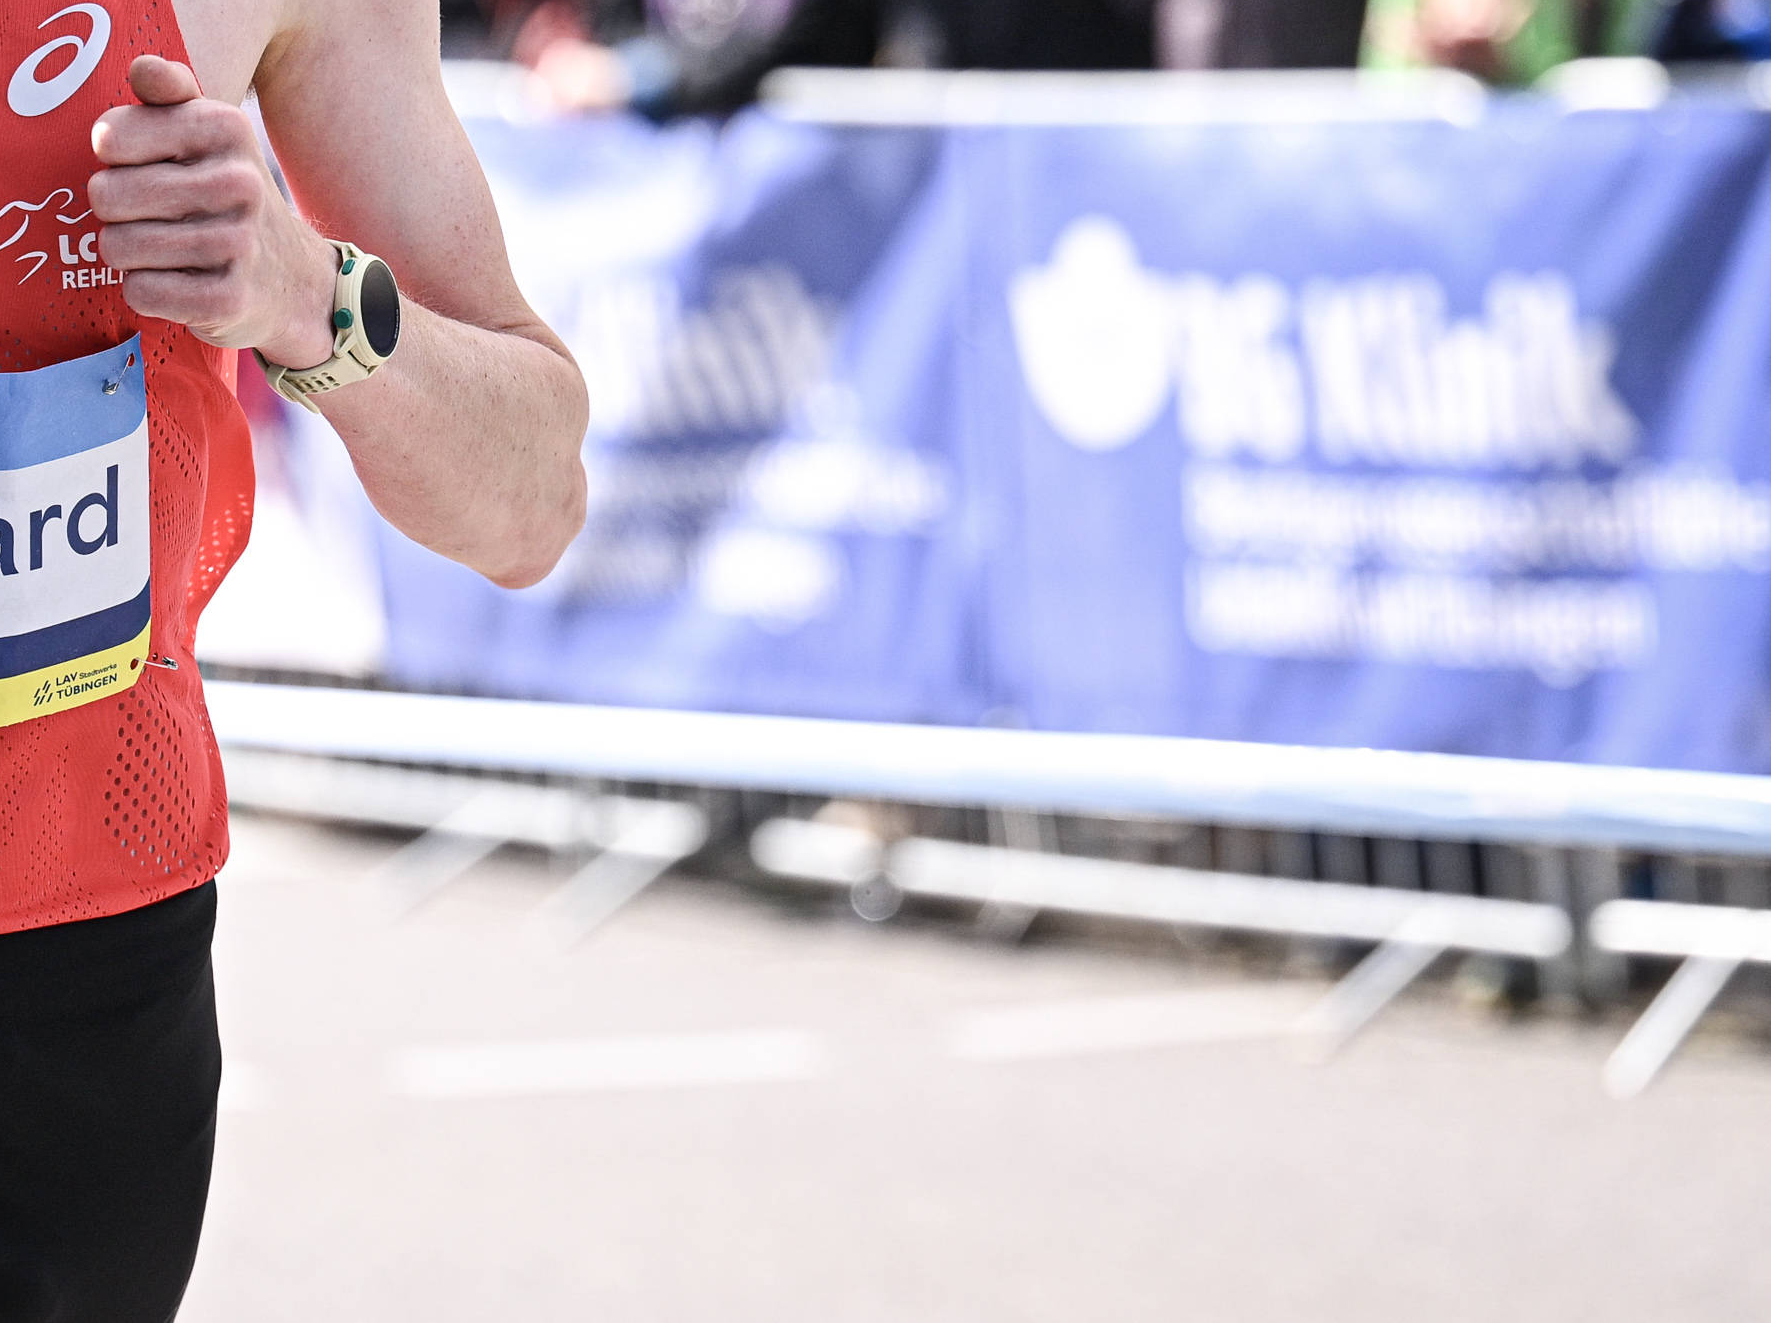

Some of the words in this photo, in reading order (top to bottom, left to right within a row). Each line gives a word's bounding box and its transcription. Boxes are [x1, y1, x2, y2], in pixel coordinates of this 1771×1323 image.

[58, 231, 98, 265] LC
[61, 267, 128, 290] REHLI
[55, 671, 78, 687] LAV
[56, 673, 118, 699] TÜBINGEN
